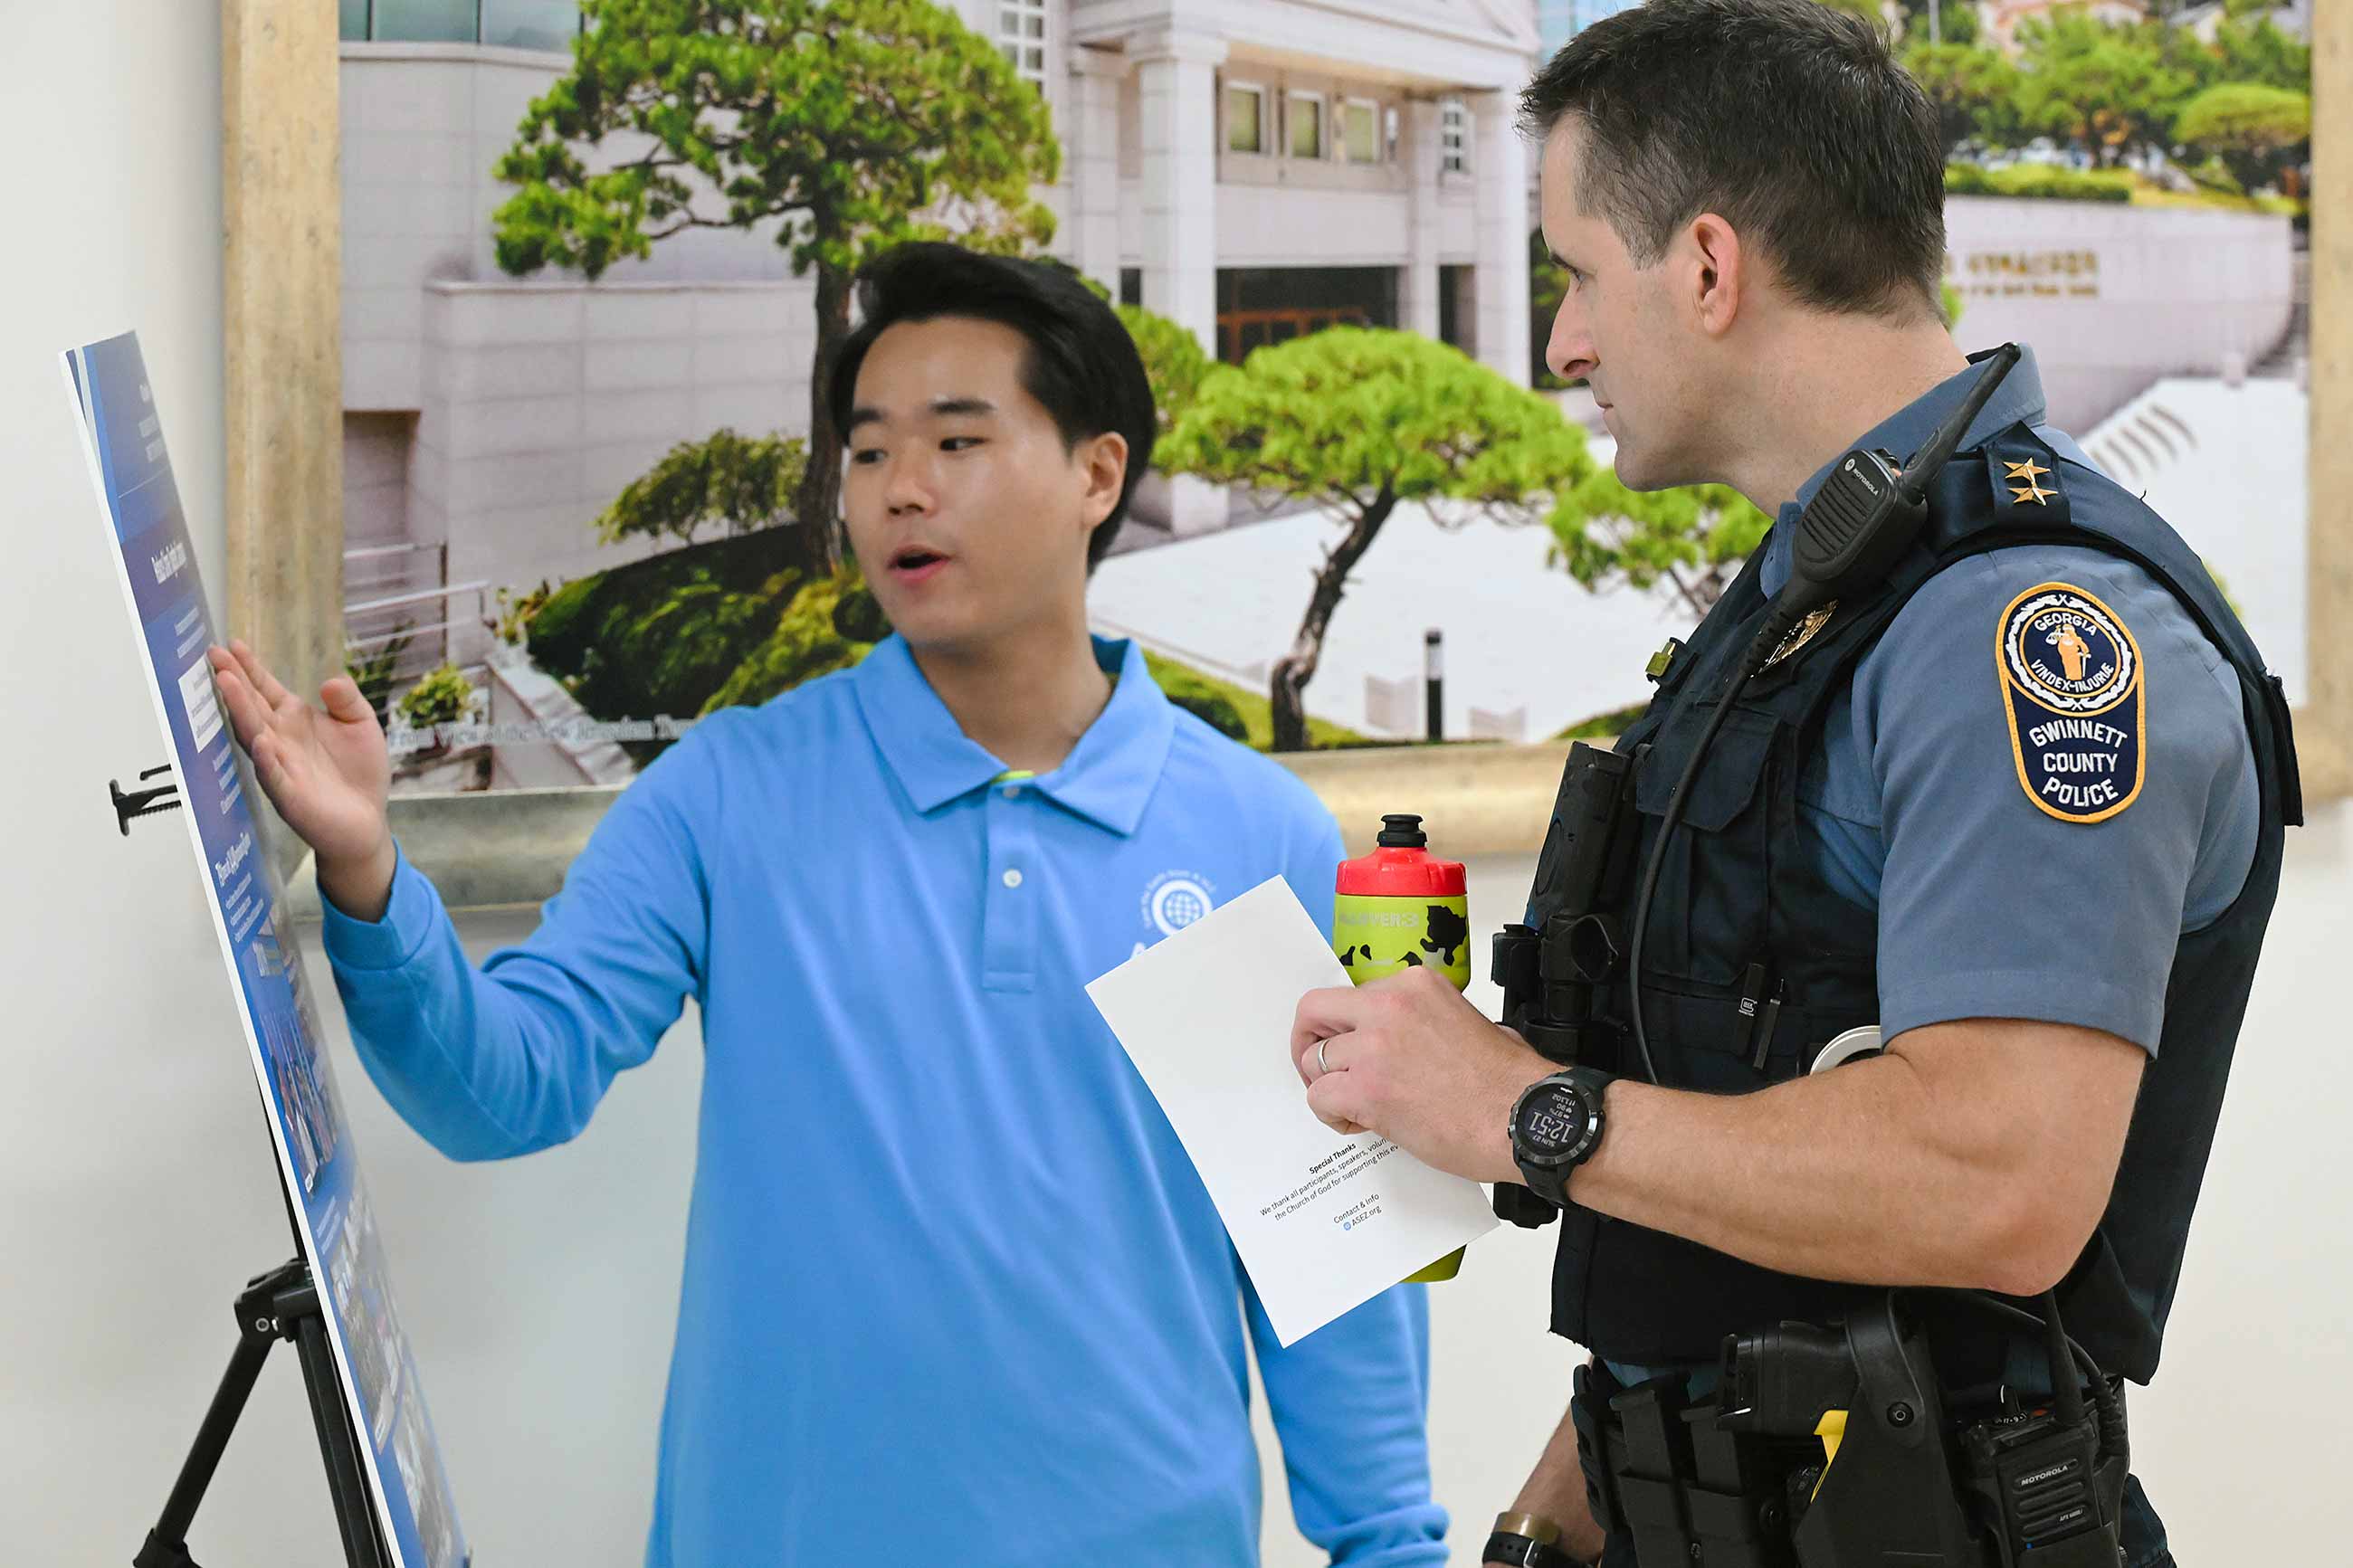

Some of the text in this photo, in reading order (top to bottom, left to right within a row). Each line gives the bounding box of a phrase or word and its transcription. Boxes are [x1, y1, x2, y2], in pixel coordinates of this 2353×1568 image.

[1853, 468, 1879, 496] MOTOROLA
[2034, 613, 2098, 637] GEORGIA
[2028, 718, 2128, 748] GWINNETT
[2043, 752, 2119, 774] COUNTY
[2041, 776, 2120, 808] POLICE
[1529, 1111, 1575, 1144] 12:51
[1541, 1136, 1556, 1147] SUN
[1309, 1143, 1357, 1174] Special Thanks
[1259, 1136, 1391, 1217] We thank all participants, speakers, volun
[1274, 1209, 1287, 1221] the
[1286, 1196, 1310, 1214] Church
[1310, 1190, 1318, 1201] of
[1317, 1183, 1332, 1195] God
[1331, 1176, 1342, 1187] for
[1340, 1155, 1378, 1182] supporting
[1376, 1148, 1391, 1161] this
[1333, 1204, 1360, 1224] Contact
[1366, 1193, 1380, 1206] Info
[1351, 1205, 1382, 1227] ASEZ.org
[2020, 1465, 2069, 1487] MOTOROLA
